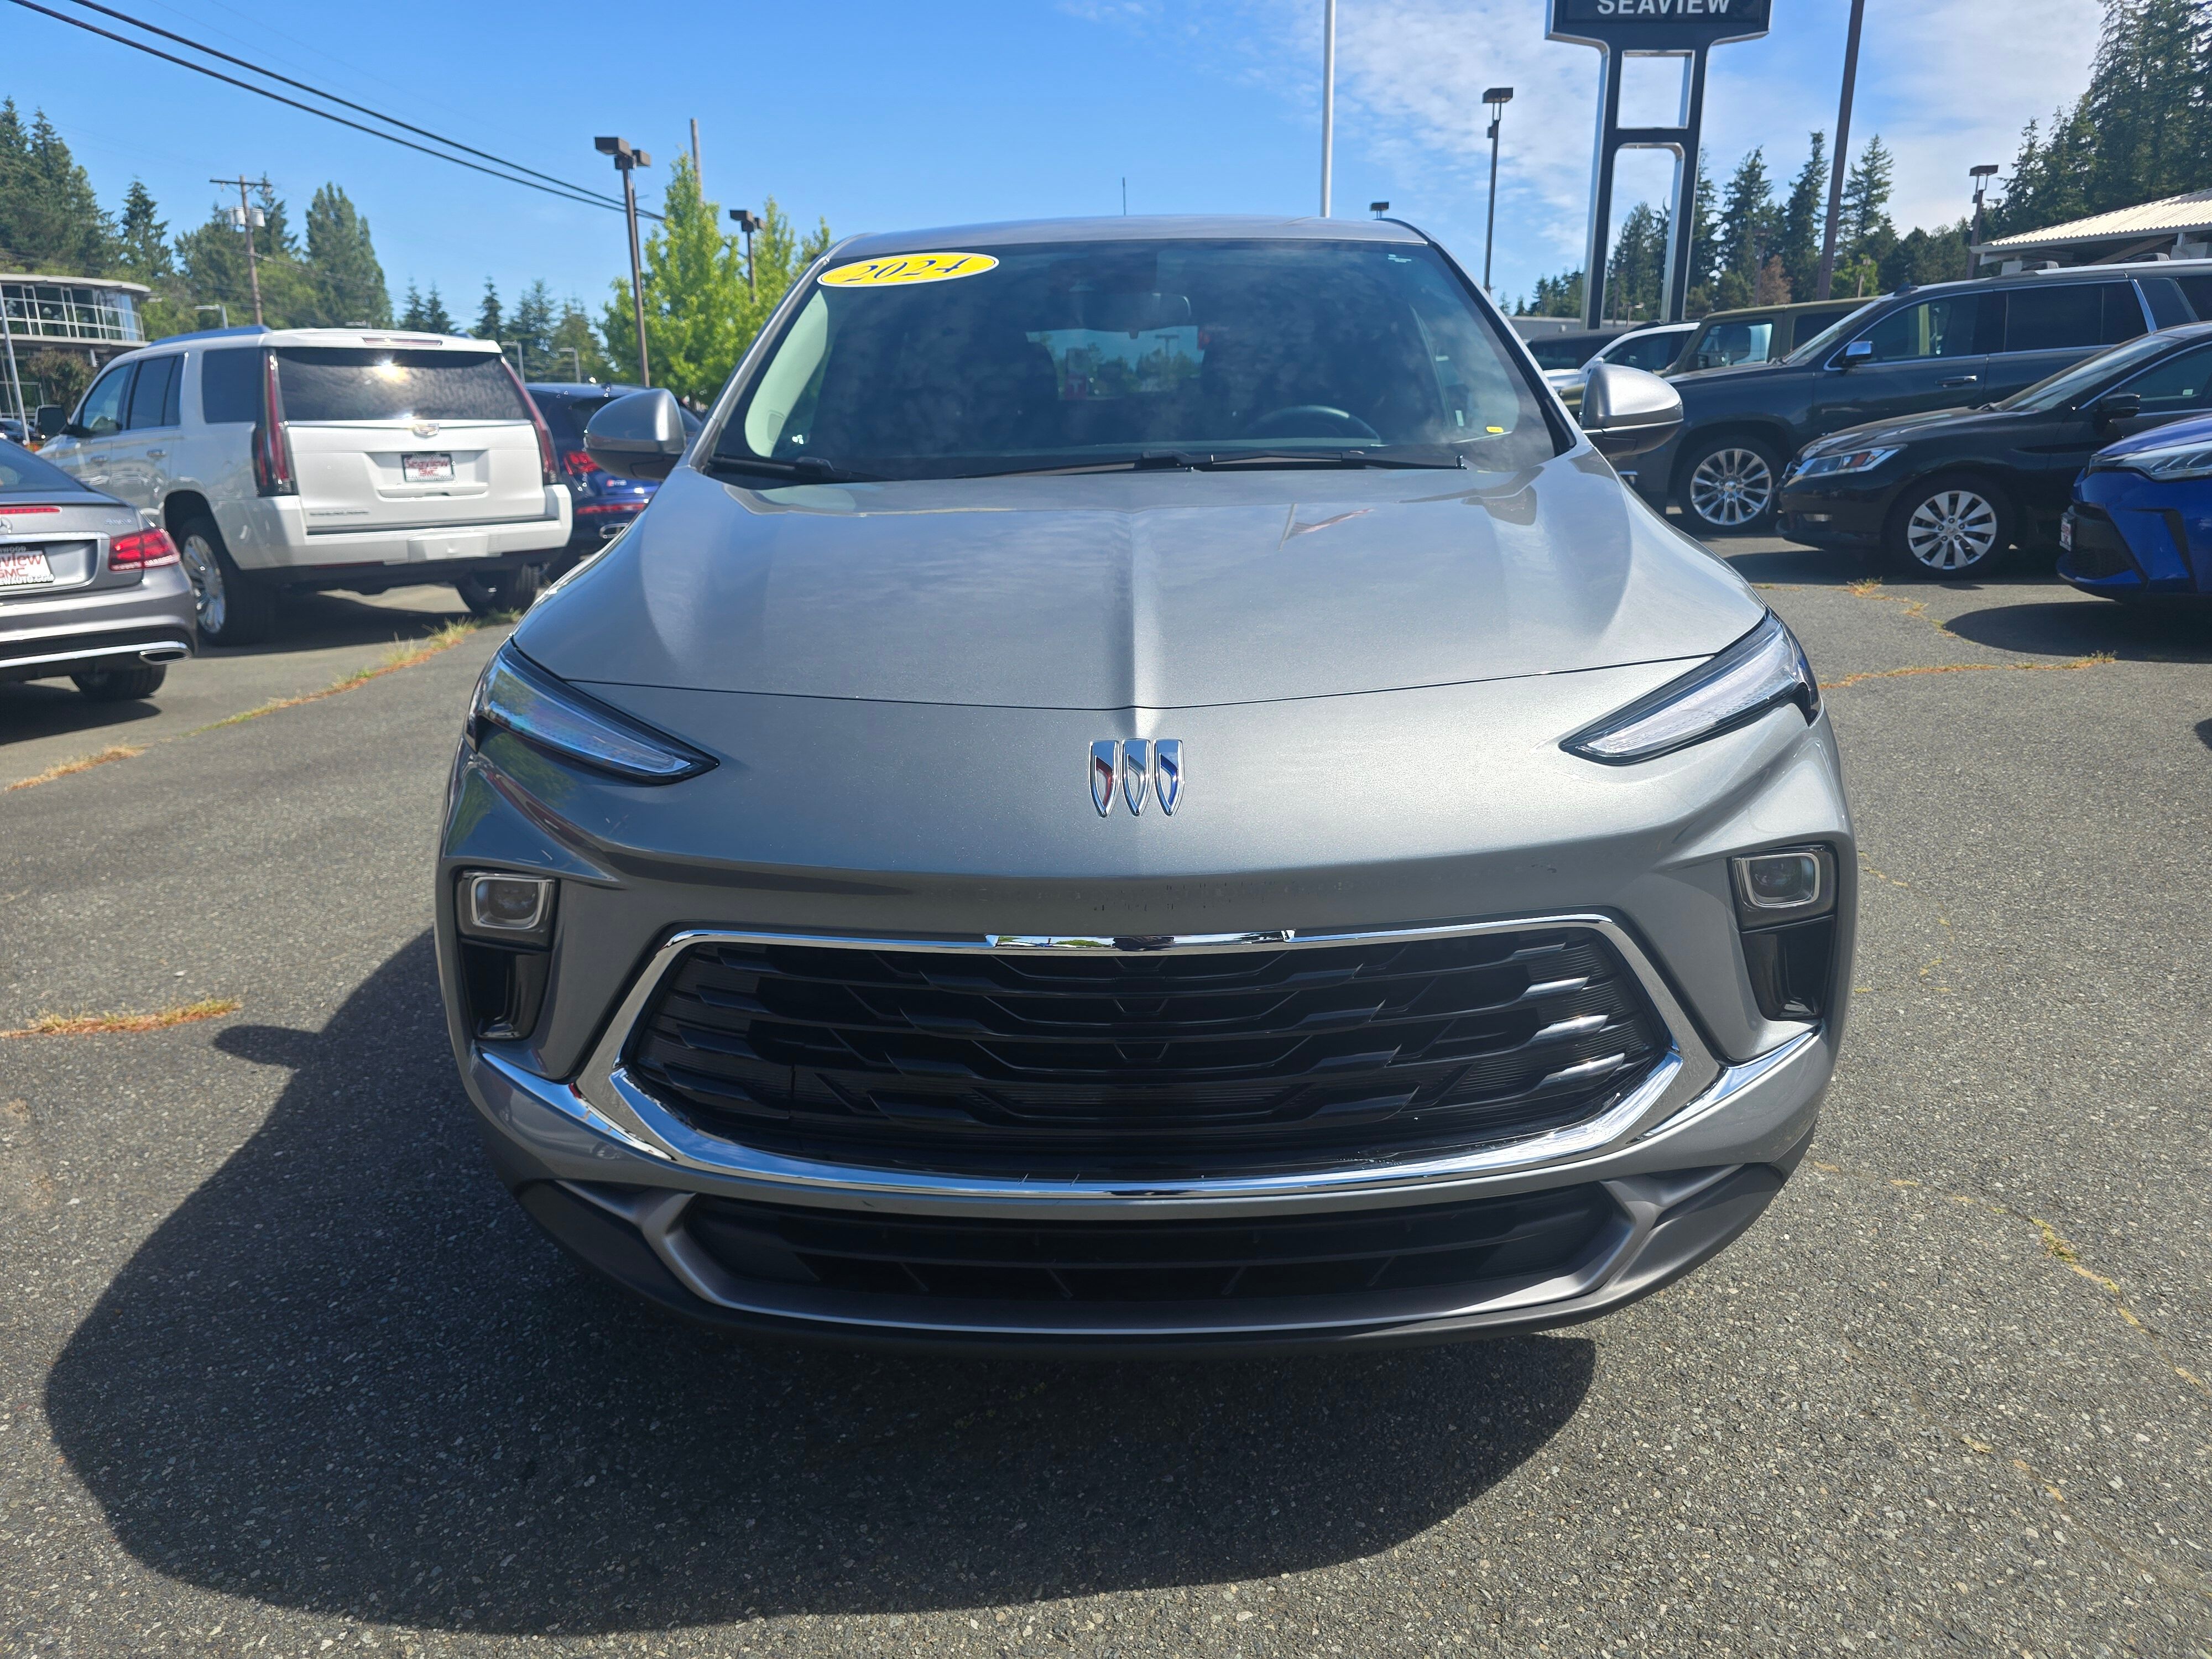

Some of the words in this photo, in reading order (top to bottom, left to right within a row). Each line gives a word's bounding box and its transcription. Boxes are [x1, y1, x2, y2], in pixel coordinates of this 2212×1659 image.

[1597, 0, 1729, 14] SEAVIEW
[841, 257, 972, 282] 2024
[0, 553, 43, 567] view
